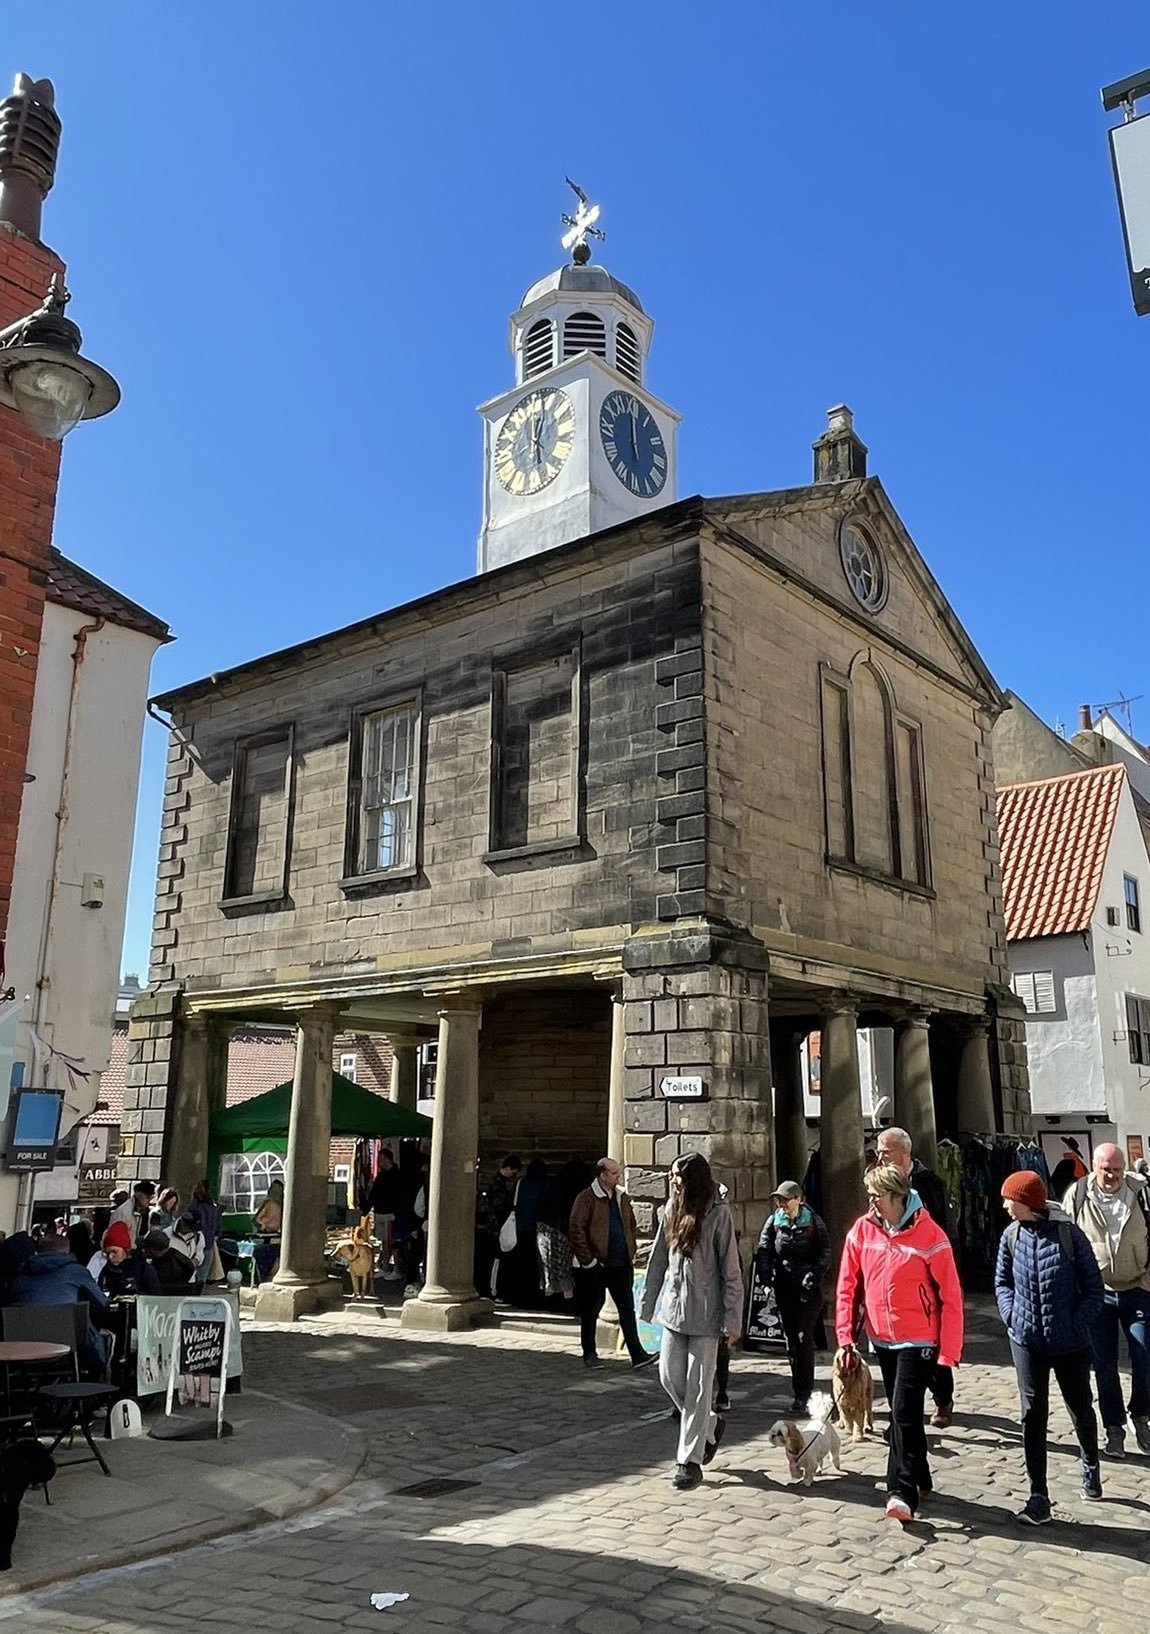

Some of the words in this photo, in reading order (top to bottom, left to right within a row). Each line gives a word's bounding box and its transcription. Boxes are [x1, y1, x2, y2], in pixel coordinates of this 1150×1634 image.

[666, 1082, 698, 1092] Toilets
[17, 1152, 31, 1160] FOR
[33, 1152, 47, 1160] SALE
[183, 1323, 220, 1345] Whitby
[185, 1341, 221, 1364] Scampi
